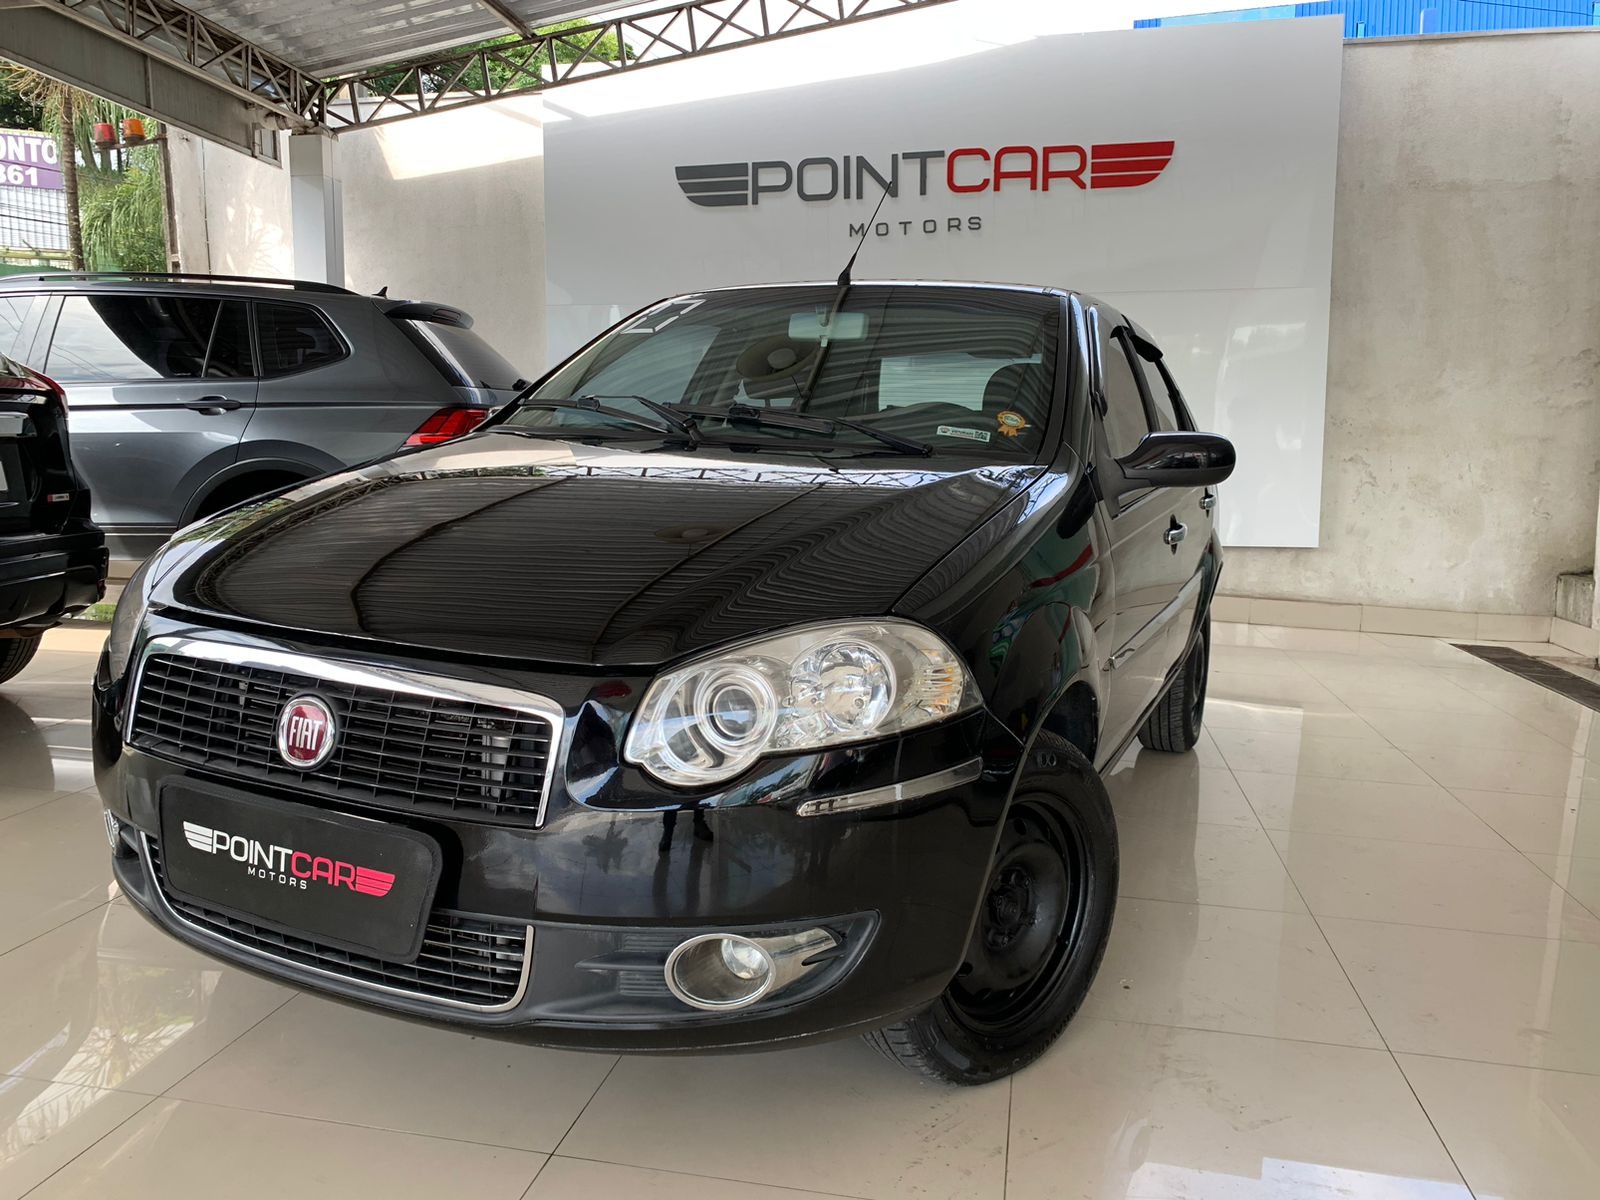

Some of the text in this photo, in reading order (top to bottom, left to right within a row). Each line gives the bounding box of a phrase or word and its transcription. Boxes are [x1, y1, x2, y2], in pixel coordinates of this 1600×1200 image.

[752, 145, 1087, 205] POINTCAR
[849, 216, 982, 237] MOTORS
[288, 716, 323, 751] FIAT
[212, 830, 357, 891] POINTCAR
[248, 866, 308, 890] MOTORS
